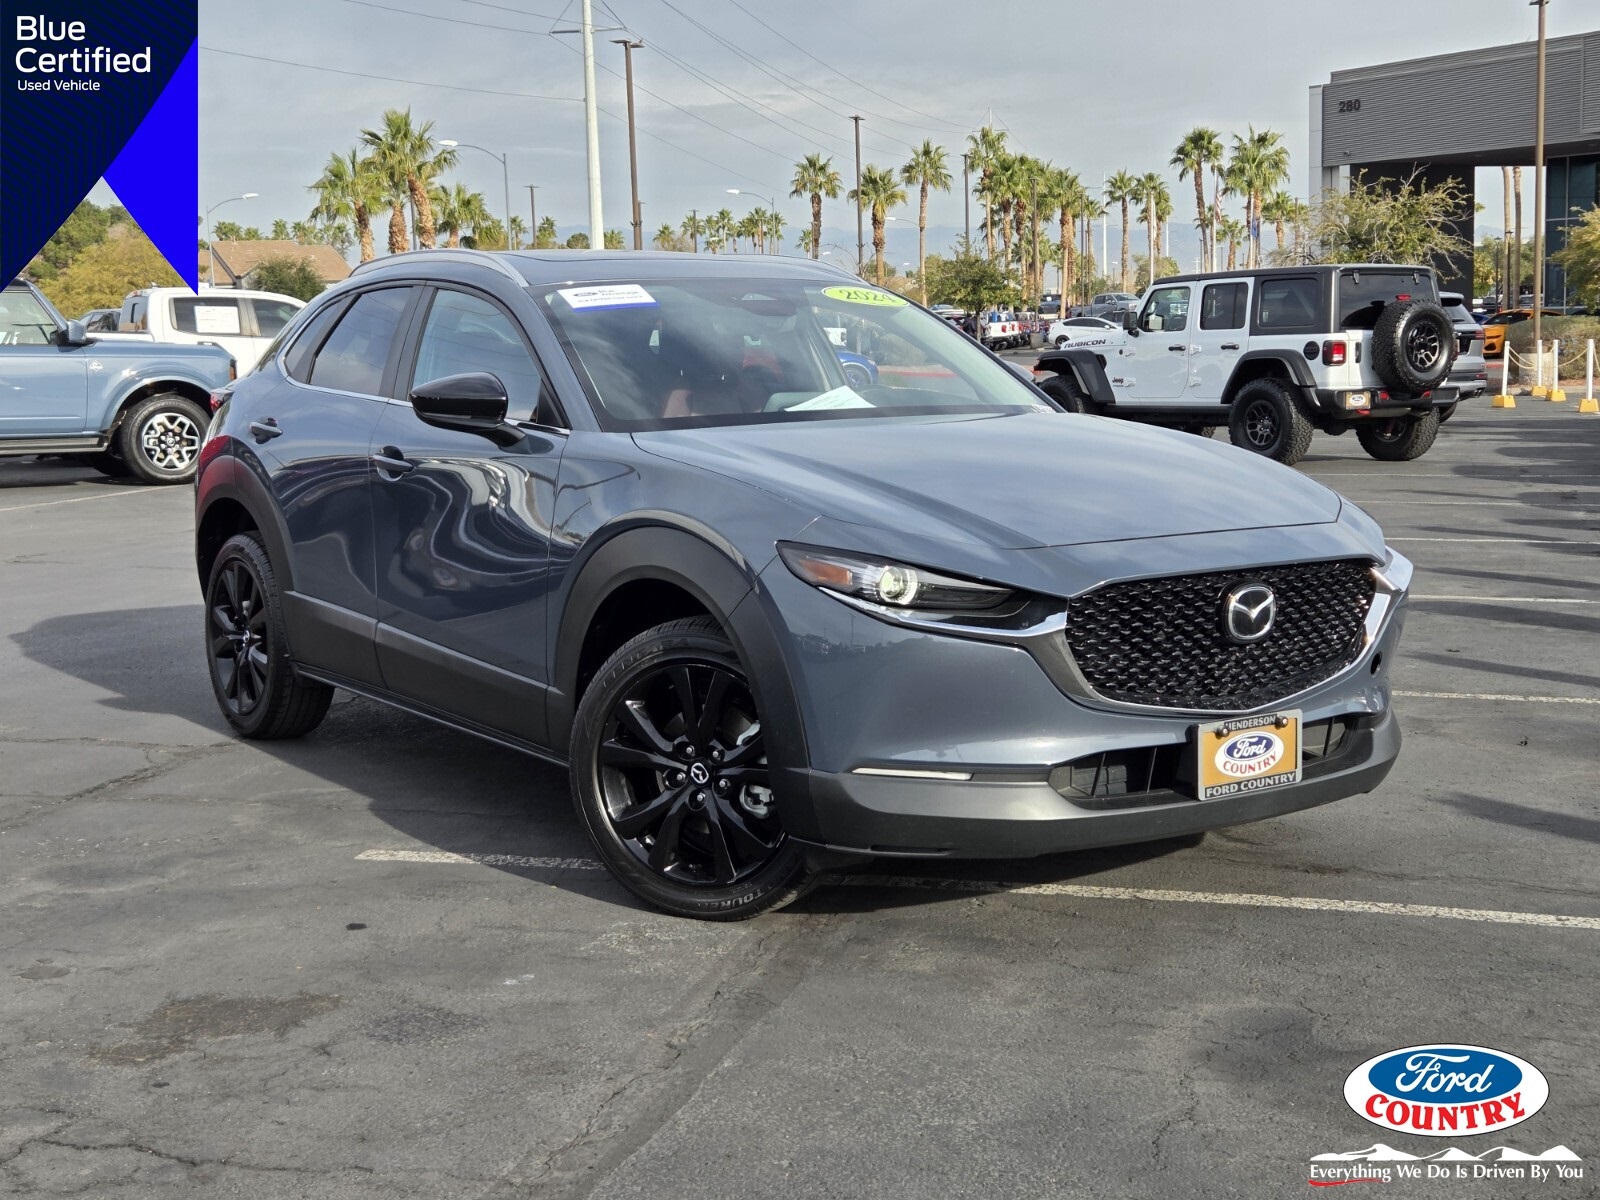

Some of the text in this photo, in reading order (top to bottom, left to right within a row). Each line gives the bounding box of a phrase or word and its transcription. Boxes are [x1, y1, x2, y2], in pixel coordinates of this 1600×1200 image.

[1338, 99, 1361, 113] 280
[839, 289, 897, 303] 2024
[1064, 339, 1107, 349] RUBICON
[1233, 736, 1267, 758] Ford
[1223, 751, 1277, 775] COUNTRY
[1206, 772, 1296, 798] FORD COUNTRY
